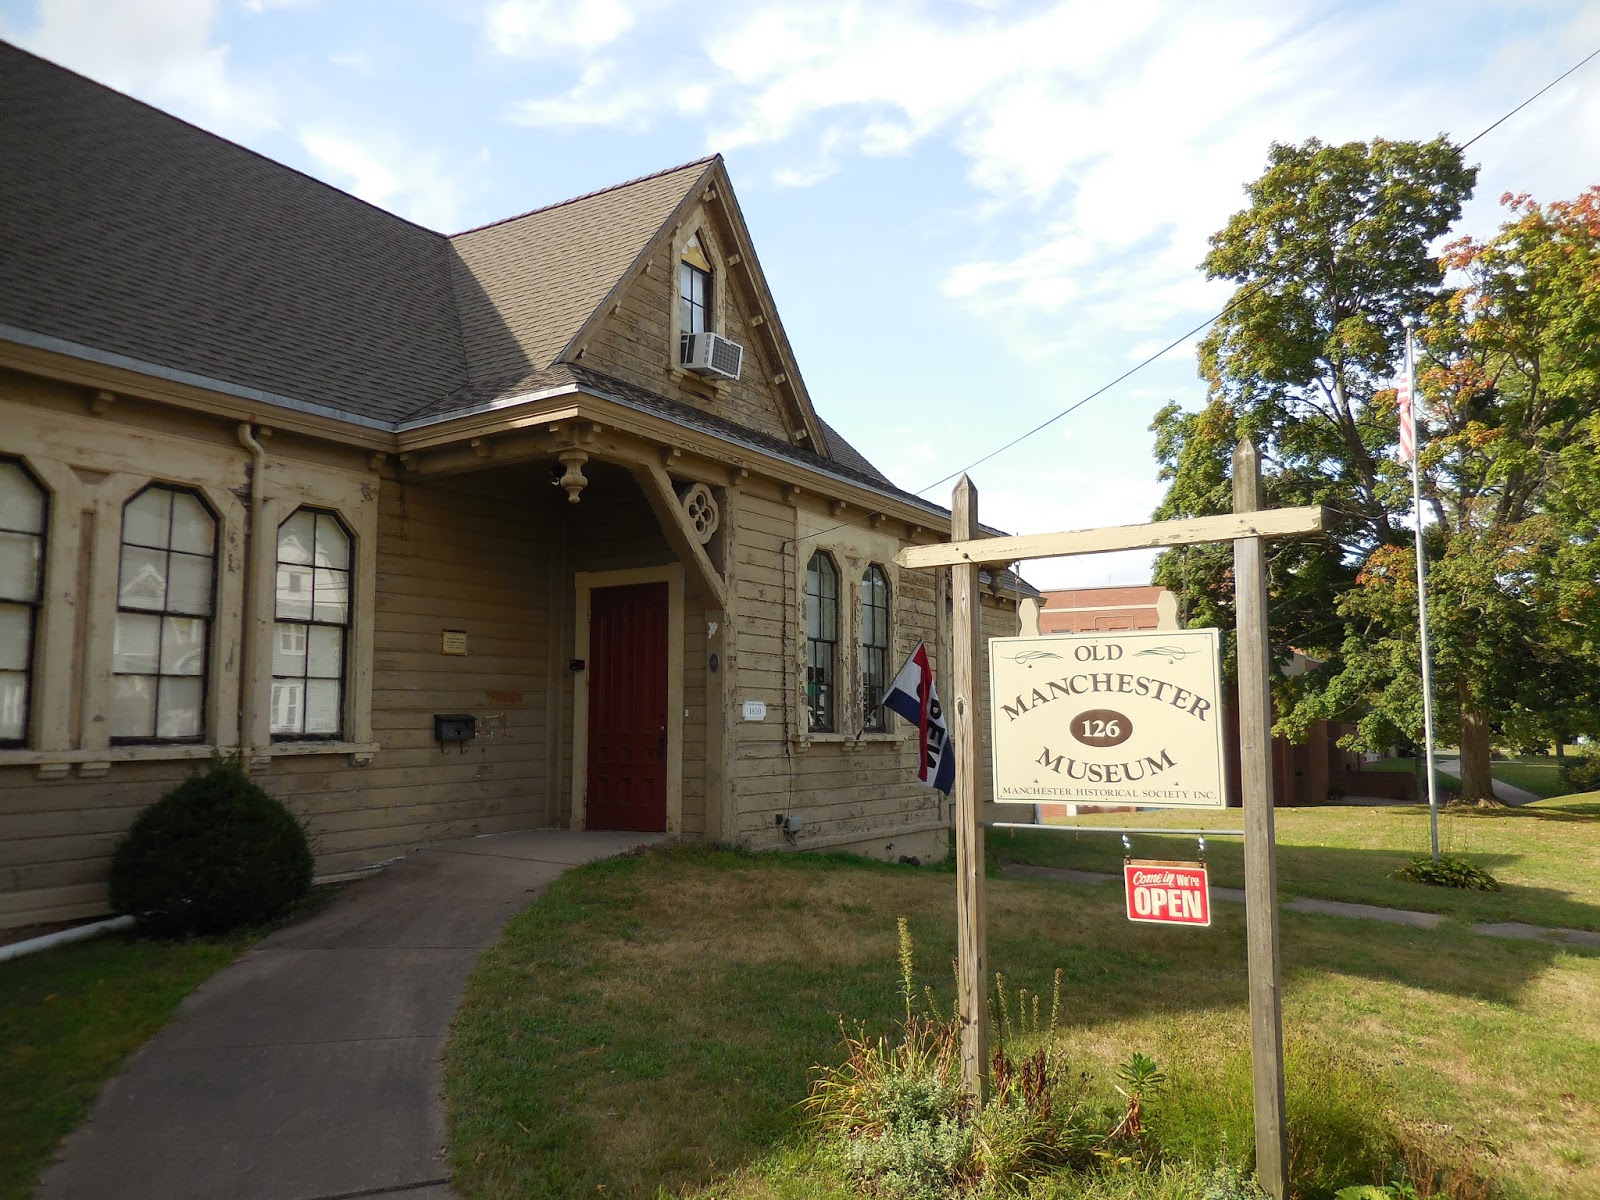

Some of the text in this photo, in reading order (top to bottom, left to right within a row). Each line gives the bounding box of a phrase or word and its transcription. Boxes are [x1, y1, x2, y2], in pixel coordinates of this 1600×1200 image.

[1074, 644, 1123, 662] OLD
[1000, 673, 1211, 722] MANCHESTER
[1081, 719, 1121, 738] 126
[1035, 746, 1177, 783] MUSEUM
[1002, 786, 1217, 800] MANCHESTER HISTORICAL SOCIETY INC.
[1132, 870, 1200, 887] Come in We're
[1133, 886, 1203, 919] OPEN
